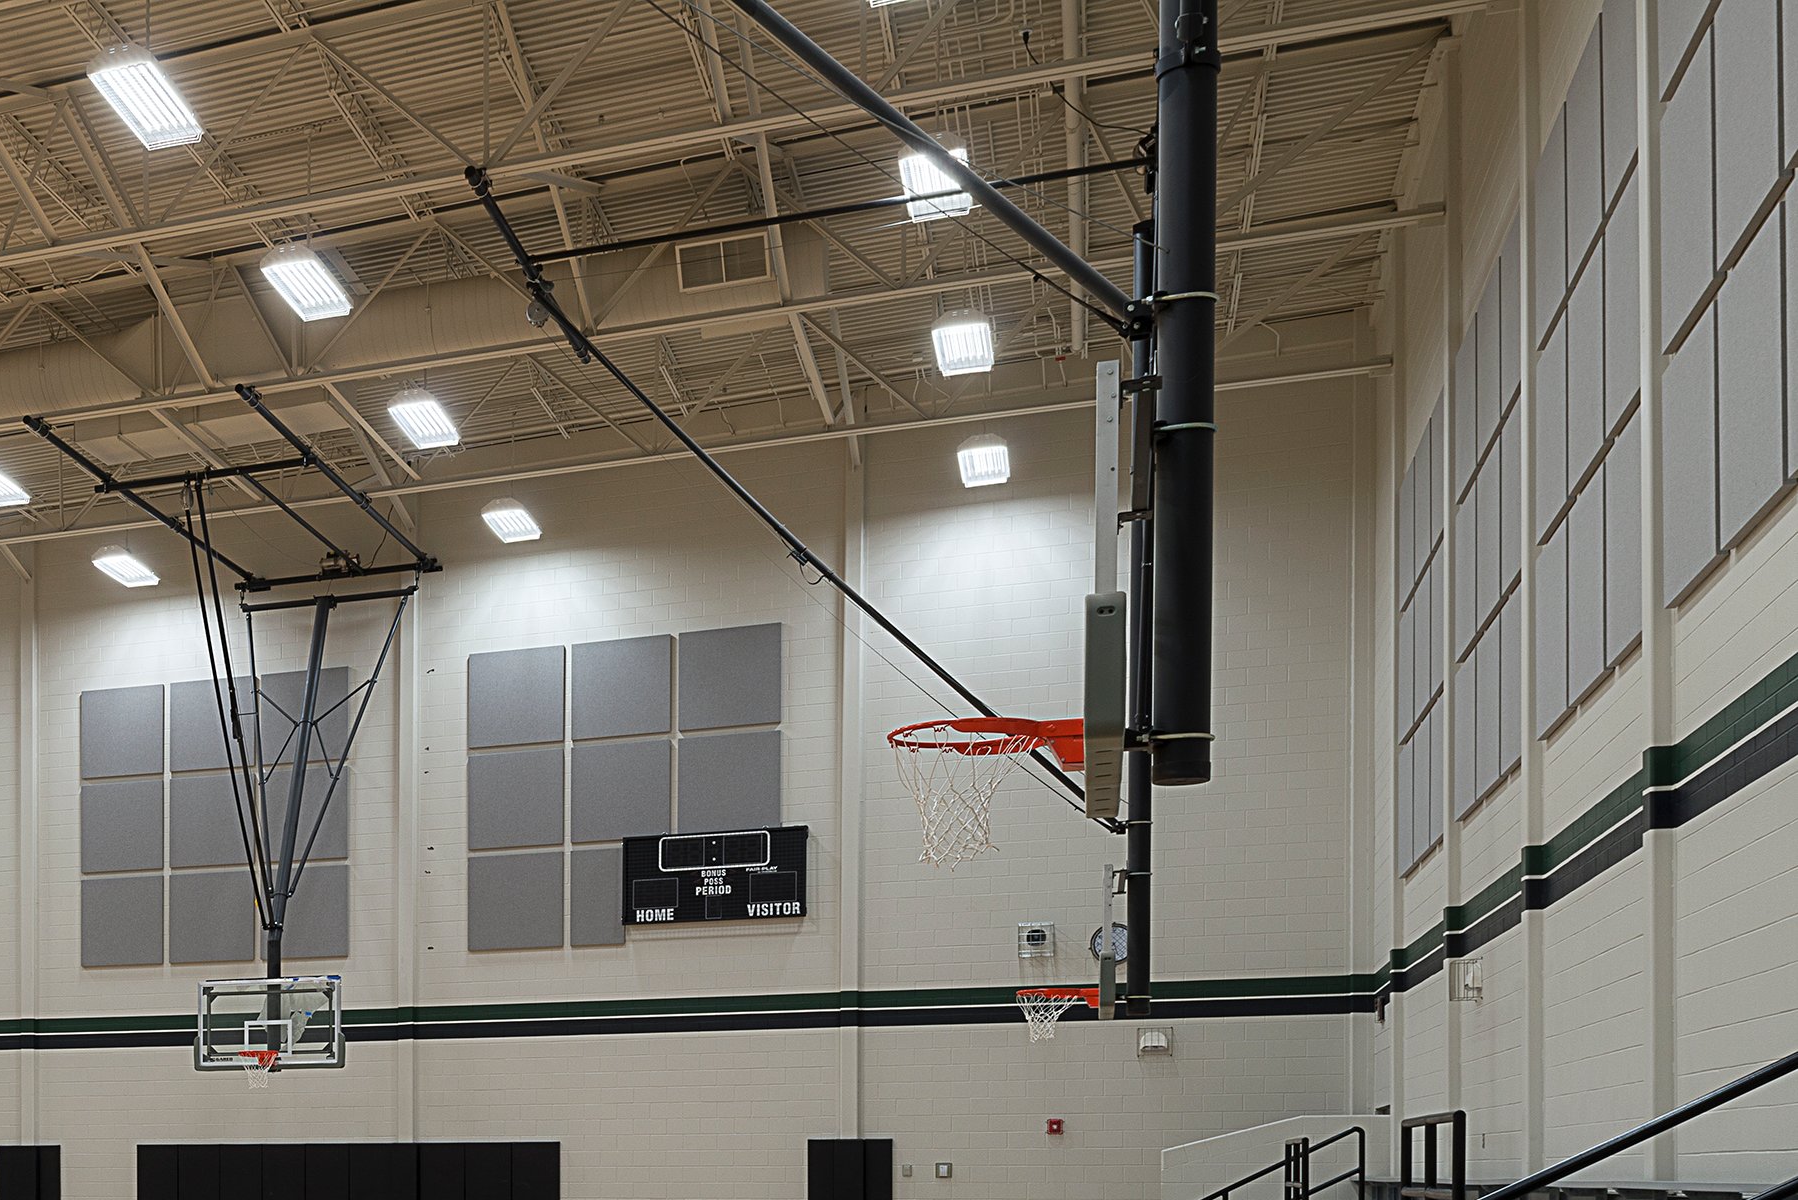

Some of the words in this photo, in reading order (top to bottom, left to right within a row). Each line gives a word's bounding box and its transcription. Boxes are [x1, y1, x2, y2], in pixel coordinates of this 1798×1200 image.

[701, 869, 727, 878] BONUS
[703, 877, 724, 886] POSS
[695, 885, 732, 896] PERIOD
[747, 901, 801, 917] VISITOR
[636, 908, 674, 922] HOME
